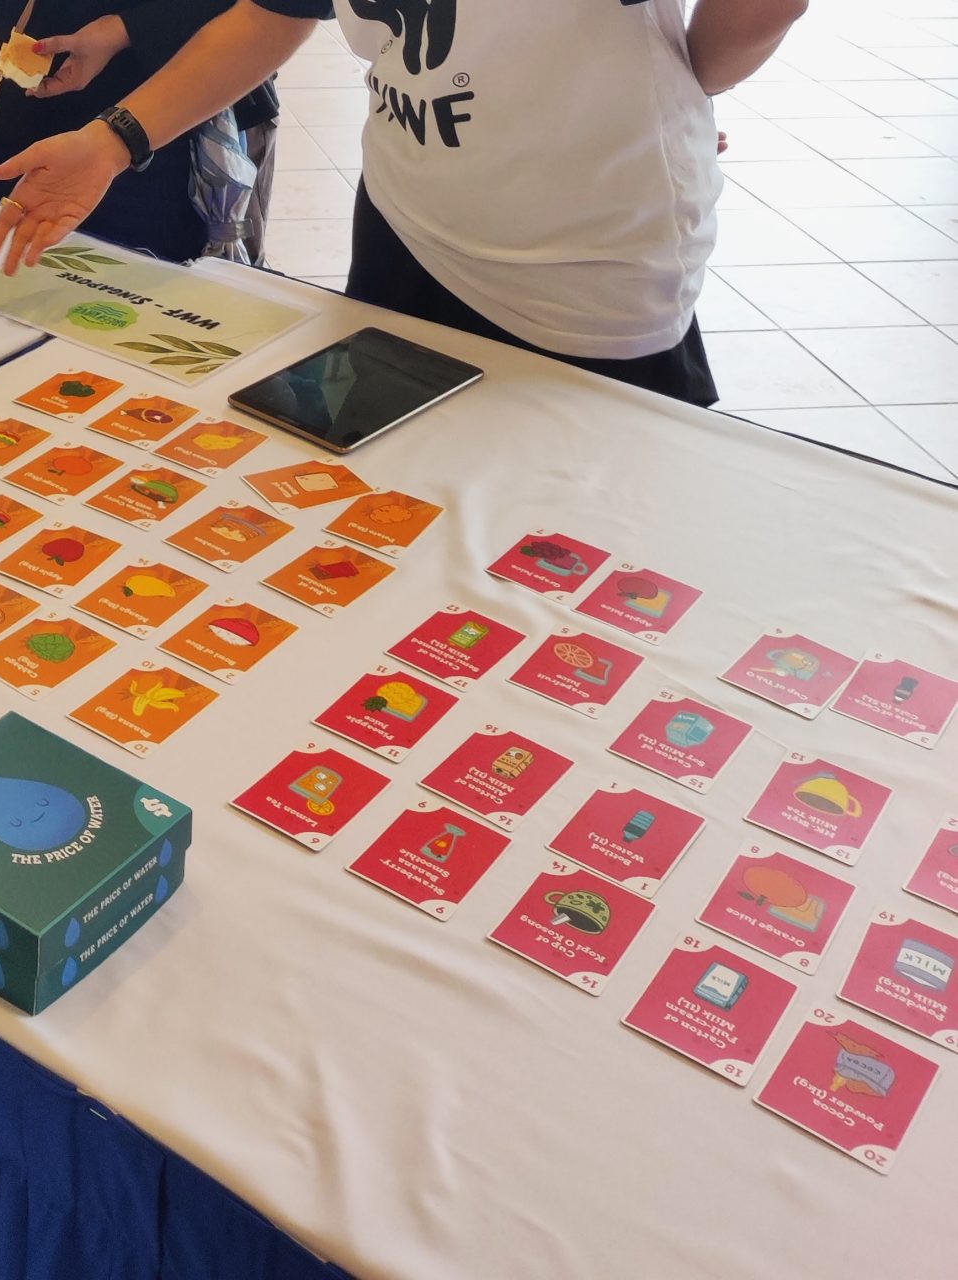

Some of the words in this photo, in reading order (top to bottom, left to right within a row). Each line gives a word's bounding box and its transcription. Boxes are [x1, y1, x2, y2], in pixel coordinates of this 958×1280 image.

[56, 271, 153, 305] SINGAPORE
[161, 308, 221, 330] WWF
[368, 528, 396, 543] Potato
[38, 568, 63, 581] Apple
[511, 564, 533, 578] Juice
[298, 574, 338, 596] Chocolate
[534, 572, 561, 589] Grape
[119, 606, 150, 623] Mango
[600, 603, 624, 618] Juice
[625, 612, 653, 629] Apple
[185, 639, 204, 651] Rice
[204, 647, 214, 657] of
[448, 646, 470, 662] Milk
[213, 652, 237, 667] Bowl
[411, 637, 480, 673] Semi-skimmed
[427, 651, 460, 672] Carton
[4, 655, 38, 679] Cabbage
[537, 672, 590, 699] Grapefruit
[556, 673, 581, 688] Juice
[786, 685, 808, 701] Cup
[118, 716, 152, 739] Banana
[346, 713, 395, 741] Pineapple
[364, 714, 389, 729] Juice
[485, 724, 499, 733] 16
[655, 748, 692, 769] Carton
[658, 742, 686, 759] Milk
[687, 754, 706, 768] Soy
[454, 778, 467, 787] of
[464, 773, 507, 797] Almond
[487, 776, 515, 793] Milk
[690, 778, 706, 789] 15
[266, 795, 281, 809] Tea
[468, 782, 504, 805] Carton
[86, 795, 104, 834] WATER
[283, 805, 319, 828] Lemon
[499, 815, 513, 826] 16
[786, 805, 807, 818] Tea
[808, 814, 838, 831] Milk
[80, 829, 95, 847] OF
[11, 852, 41, 865] THE
[45, 840, 84, 863] PRICE
[591, 842, 632, 867] Bottled
[610, 842, 644, 864] Water
[836, 849, 851, 860] 13
[398, 848, 450, 878] Smoothie
[398, 856, 439, 883] Banana
[552, 860, 568, 873] 14
[379, 857, 446, 896] Strawberry-
[82, 908, 98, 924] THE
[100, 887, 122, 912] PRICE
[122, 880, 132, 894] OF
[133, 856, 158, 883] WATER
[725, 907, 757, 926] Juice
[879, 911, 895, 922] 19
[79, 947, 95, 964] THE
[96, 926, 118, 951] PRICE
[118, 917, 129, 932] OF
[129, 893, 155, 920] WATER
[520, 914, 564, 943] Kosong
[759, 921, 806, 948] Orange
[535, 934, 549, 945] of
[684, 936, 702, 949] 18
[551, 940, 576, 958] Cup
[577, 944, 606, 963] Kopi
[904, 952, 946, 976] MILK
[582, 975, 599, 989] 14
[878, 975, 911, 997] (1kg)
[875, 984, 945, 1022] Powdered
[913, 991, 948, 1013] Milk
[663, 1013, 679, 1024] of
[665, 1001, 739, 1044] Full-cream
[702, 1009, 736, 1031] Milk
[814, 1008, 835, 1023] 20
[680, 1019, 727, 1049] Carton
[723, 1063, 745, 1078] 18
[793, 1076, 827, 1100] (1kg)
[813, 1098, 856, 1127] Cocoa
[829, 1095, 884, 1131] Powder
[864, 1149, 887, 1167] 20
